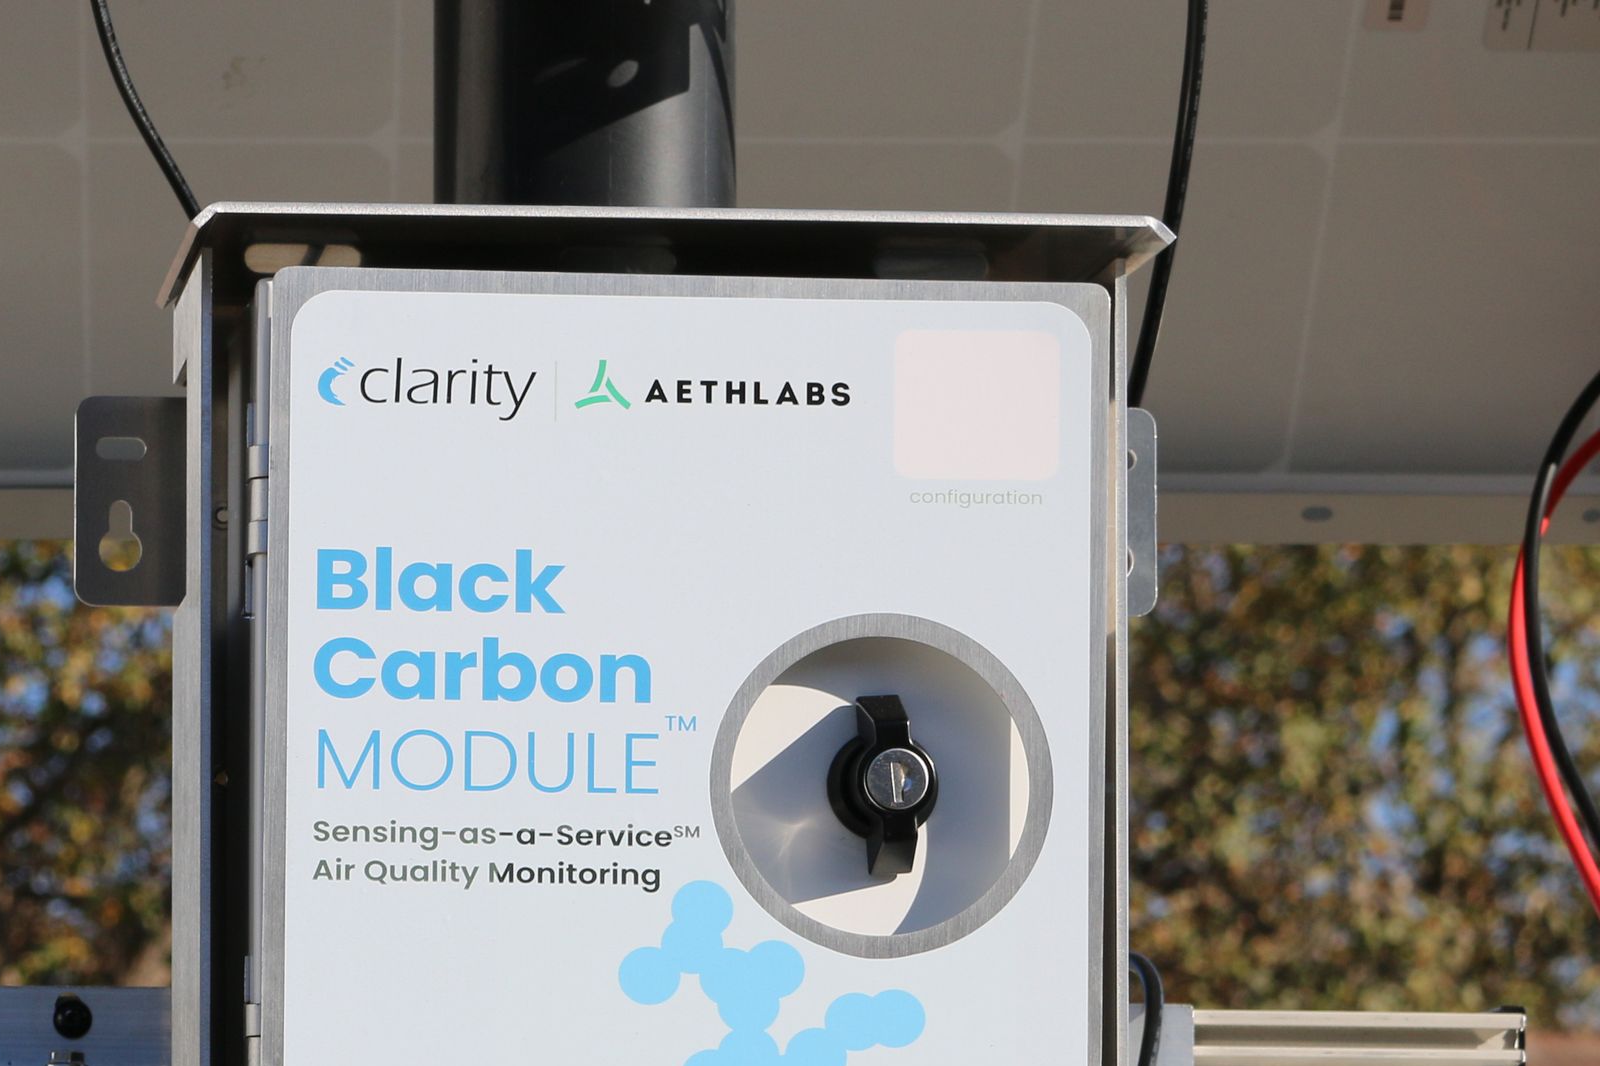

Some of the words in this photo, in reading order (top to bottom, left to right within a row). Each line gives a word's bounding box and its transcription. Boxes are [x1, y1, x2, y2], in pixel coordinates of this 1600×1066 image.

[359, 356, 538, 422] clarity
[644, 377, 852, 407] AETHLABS
[908, 485, 1045, 508] configuration
[315, 545, 567, 615] Black
[312, 635, 653, 705] Carbon
[311, 857, 357, 882] Air
[363, 858, 481, 891] Quality
[487, 860, 662, 895] Monitoring
